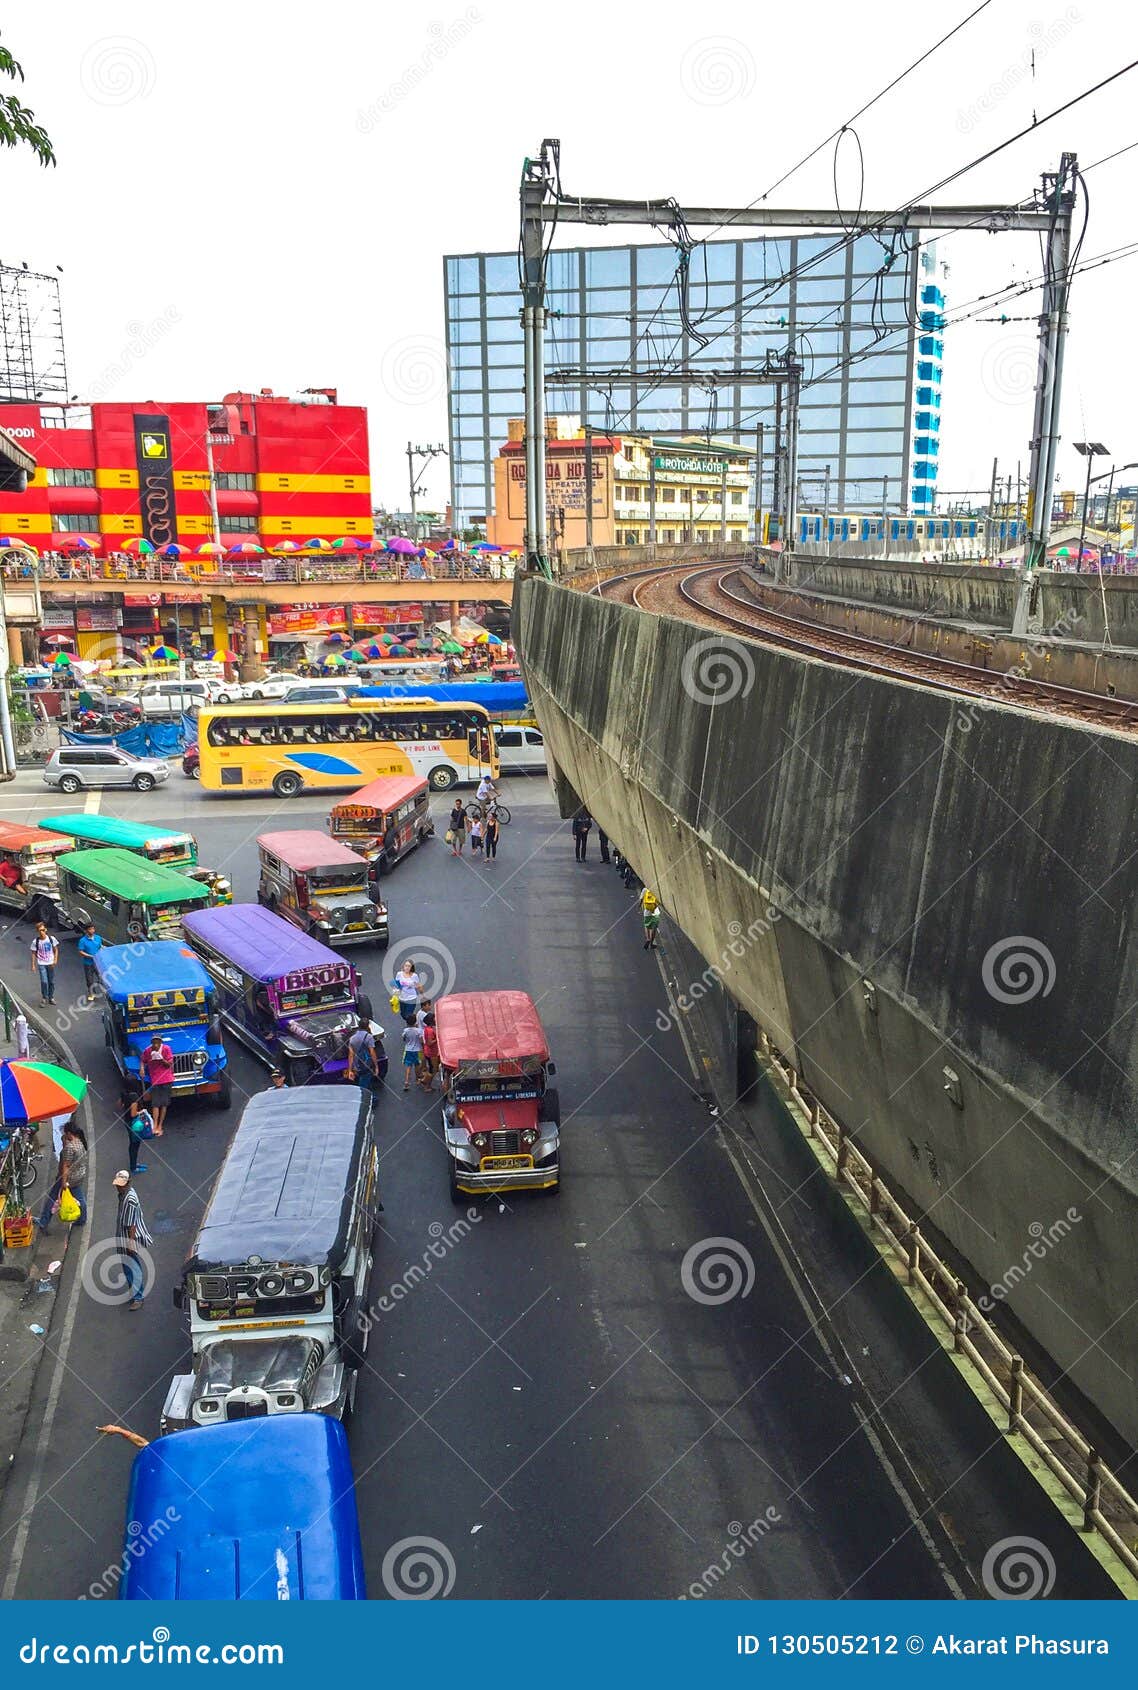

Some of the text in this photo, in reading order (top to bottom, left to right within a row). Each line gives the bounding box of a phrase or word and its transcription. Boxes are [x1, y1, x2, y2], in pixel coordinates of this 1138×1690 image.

[511, 463, 560, 478] RODA
[286, 966, 350, 991] BROD
[200, 1270, 314, 1299] BROD
